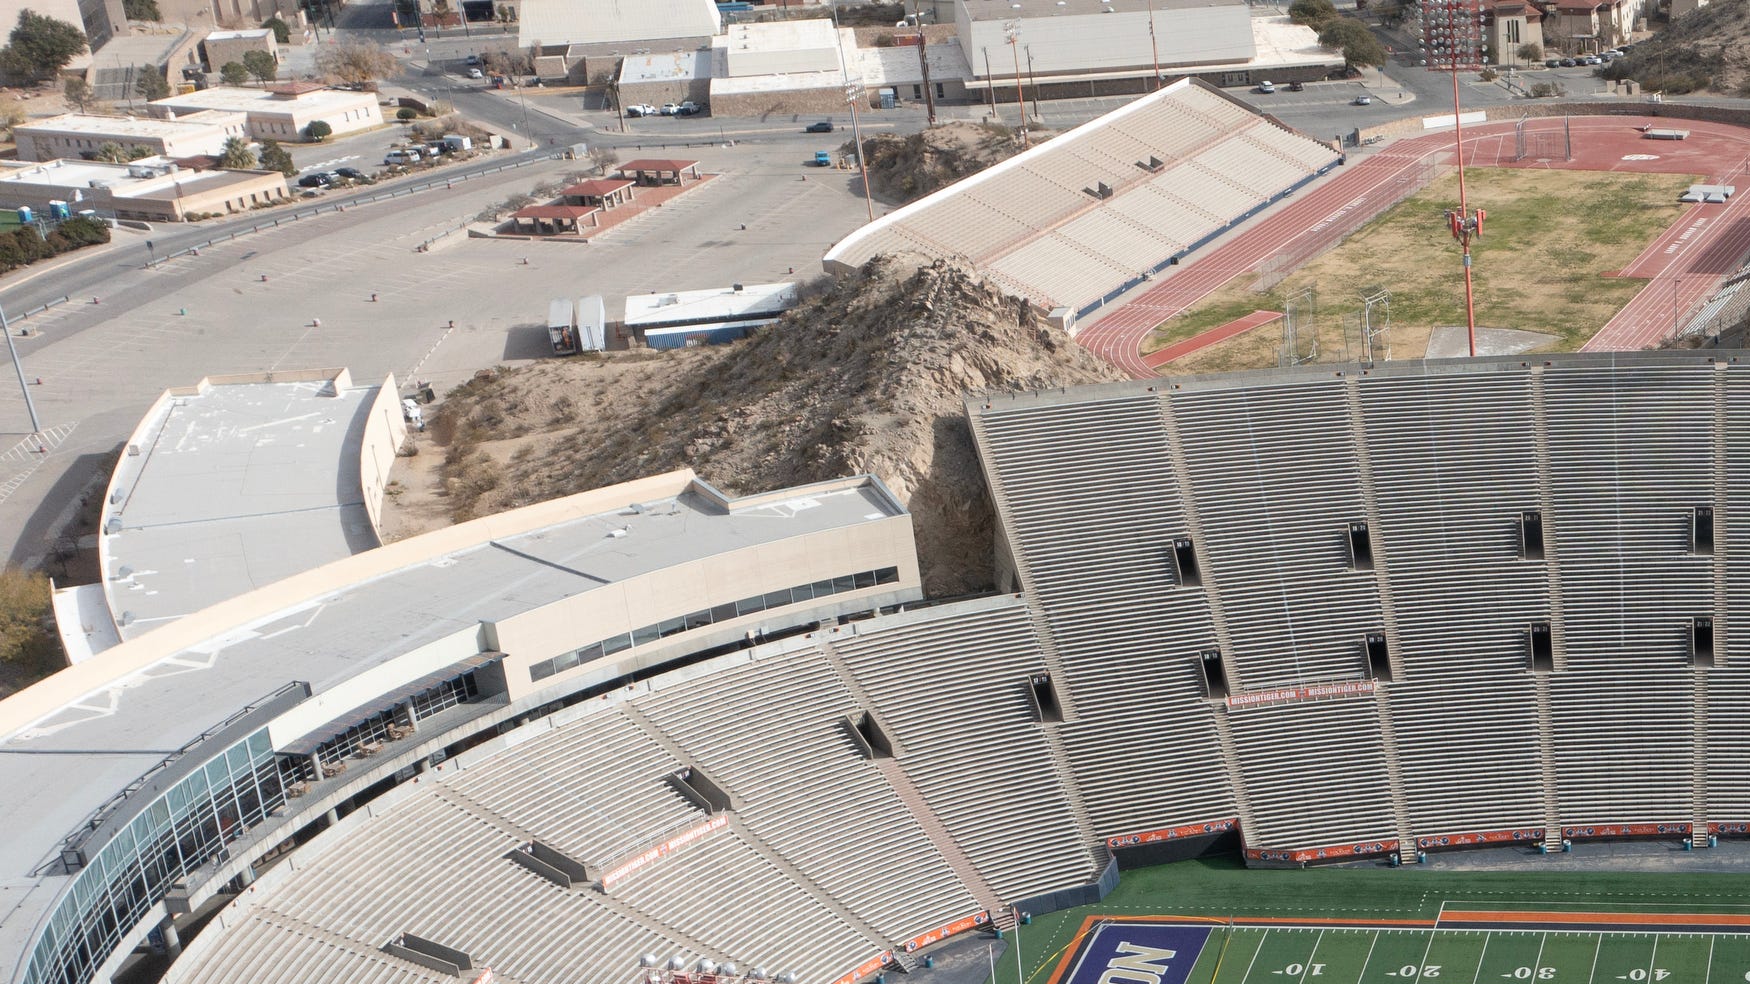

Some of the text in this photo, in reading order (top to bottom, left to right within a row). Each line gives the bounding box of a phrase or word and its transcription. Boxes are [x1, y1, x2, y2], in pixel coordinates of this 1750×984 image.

[1231, 683, 1374, 705] MISSIONTIGER.COM MISSIONTIGER.COM
[1285, 963, 1327, 976] 10
[1400, 965, 1441, 978] 20
[1513, 967, 1556, 980] 30
[1628, 968, 1671, 982] 40
